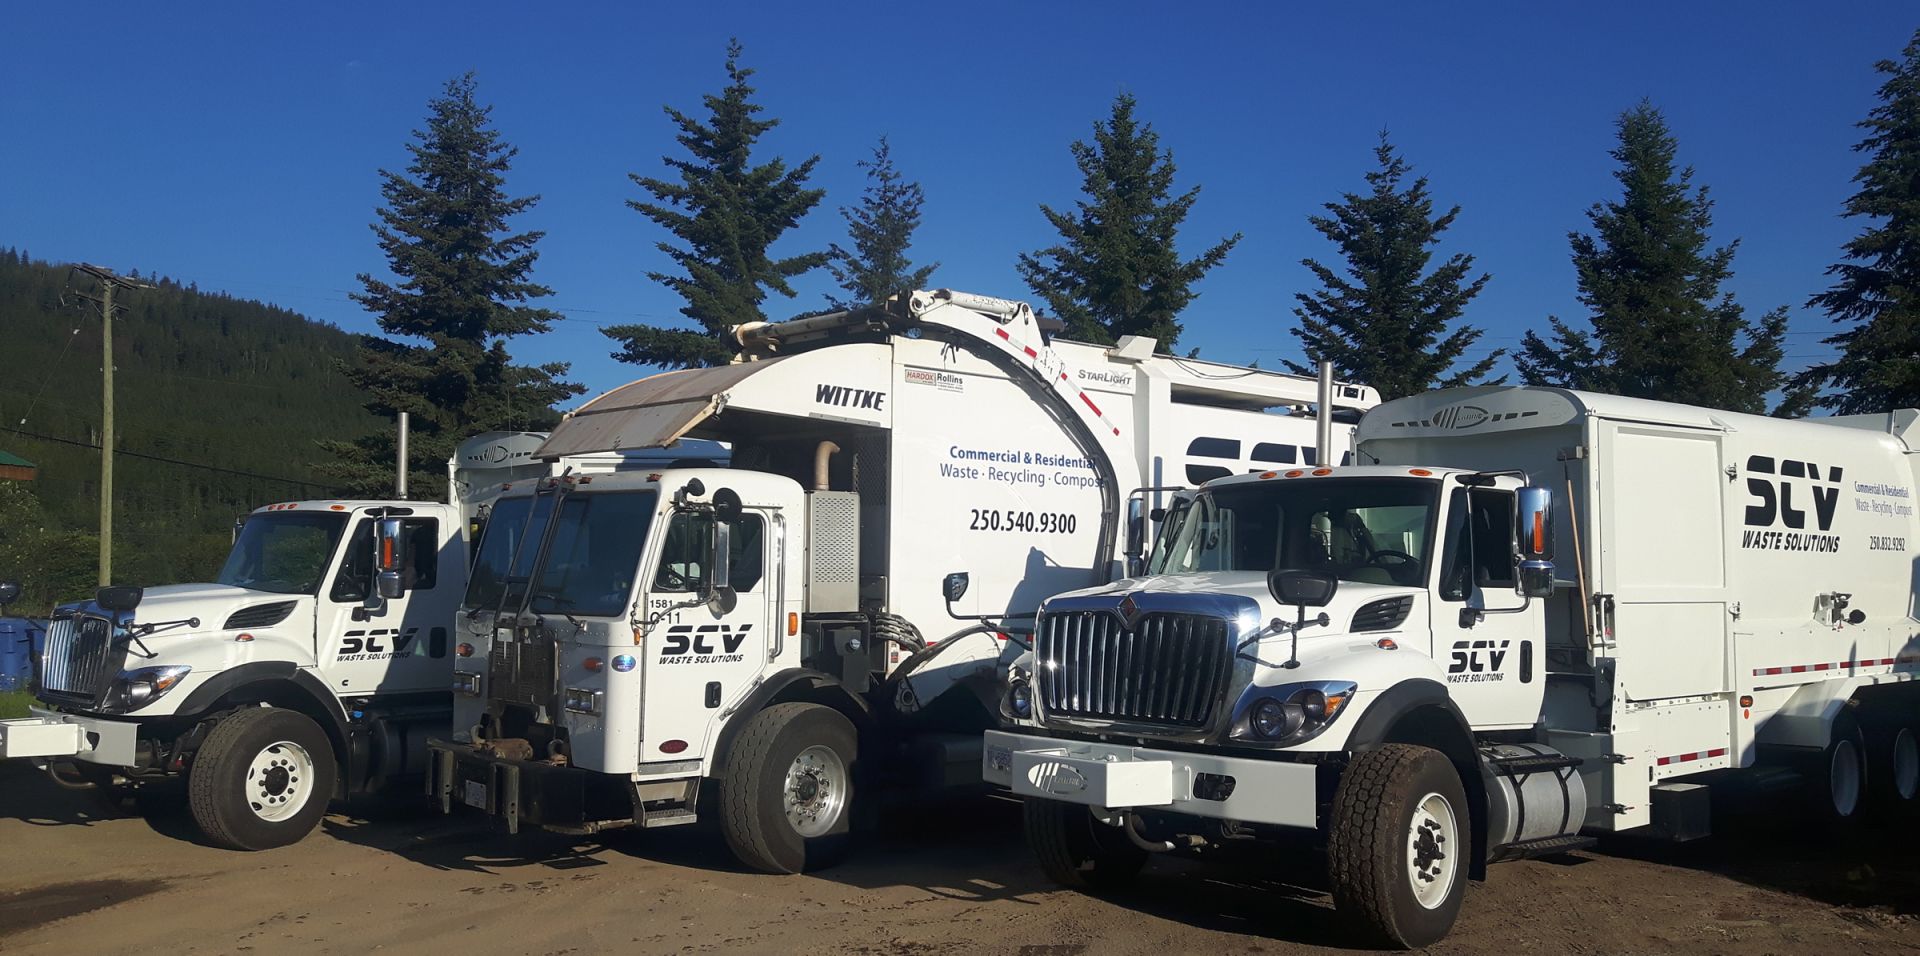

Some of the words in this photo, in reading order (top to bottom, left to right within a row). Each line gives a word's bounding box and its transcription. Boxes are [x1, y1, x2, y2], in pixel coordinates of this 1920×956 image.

[906, 371, 934, 381] HARDOX
[937, 372, 963, 385] Rollins
[816, 384, 886, 411] WITTKE
[950, 445, 1021, 464] Commercial
[1023, 451, 1032, 465] &
[1035, 452, 1096, 469] Residential
[940, 463, 979, 480] Waste
[988, 466, 1045, 488] Recycling
[1744, 455, 1843, 531] SCV
[1855, 481, 1881, 495] Commercial
[1885, 484, 1909, 499] Residential
[1855, 497, 1870, 512] Waste
[1872, 499, 1893, 518] Recycling
[1894, 502, 1912, 518] Compost
[969, 508, 1077, 534] 250.540.9300
[1742, 530, 1783, 550] WASTE
[1784, 532, 1841, 553] SOLUTIONS
[1869, 535, 1906, 552] 250.832.9292
[650, 599, 673, 609] 1581
[339, 628, 419, 654] SCV
[661, 624, 754, 655] SCV
[367, 652, 411, 660] SOLUTIONS
[659, 656, 693, 665] WASTE
[694, 654, 744, 664] SOLUTIONS
[1448, 640, 1510, 673] SCV
[1447, 675, 1470, 683] WASTE
[1471, 673, 1504, 683] SOLUTIONS
